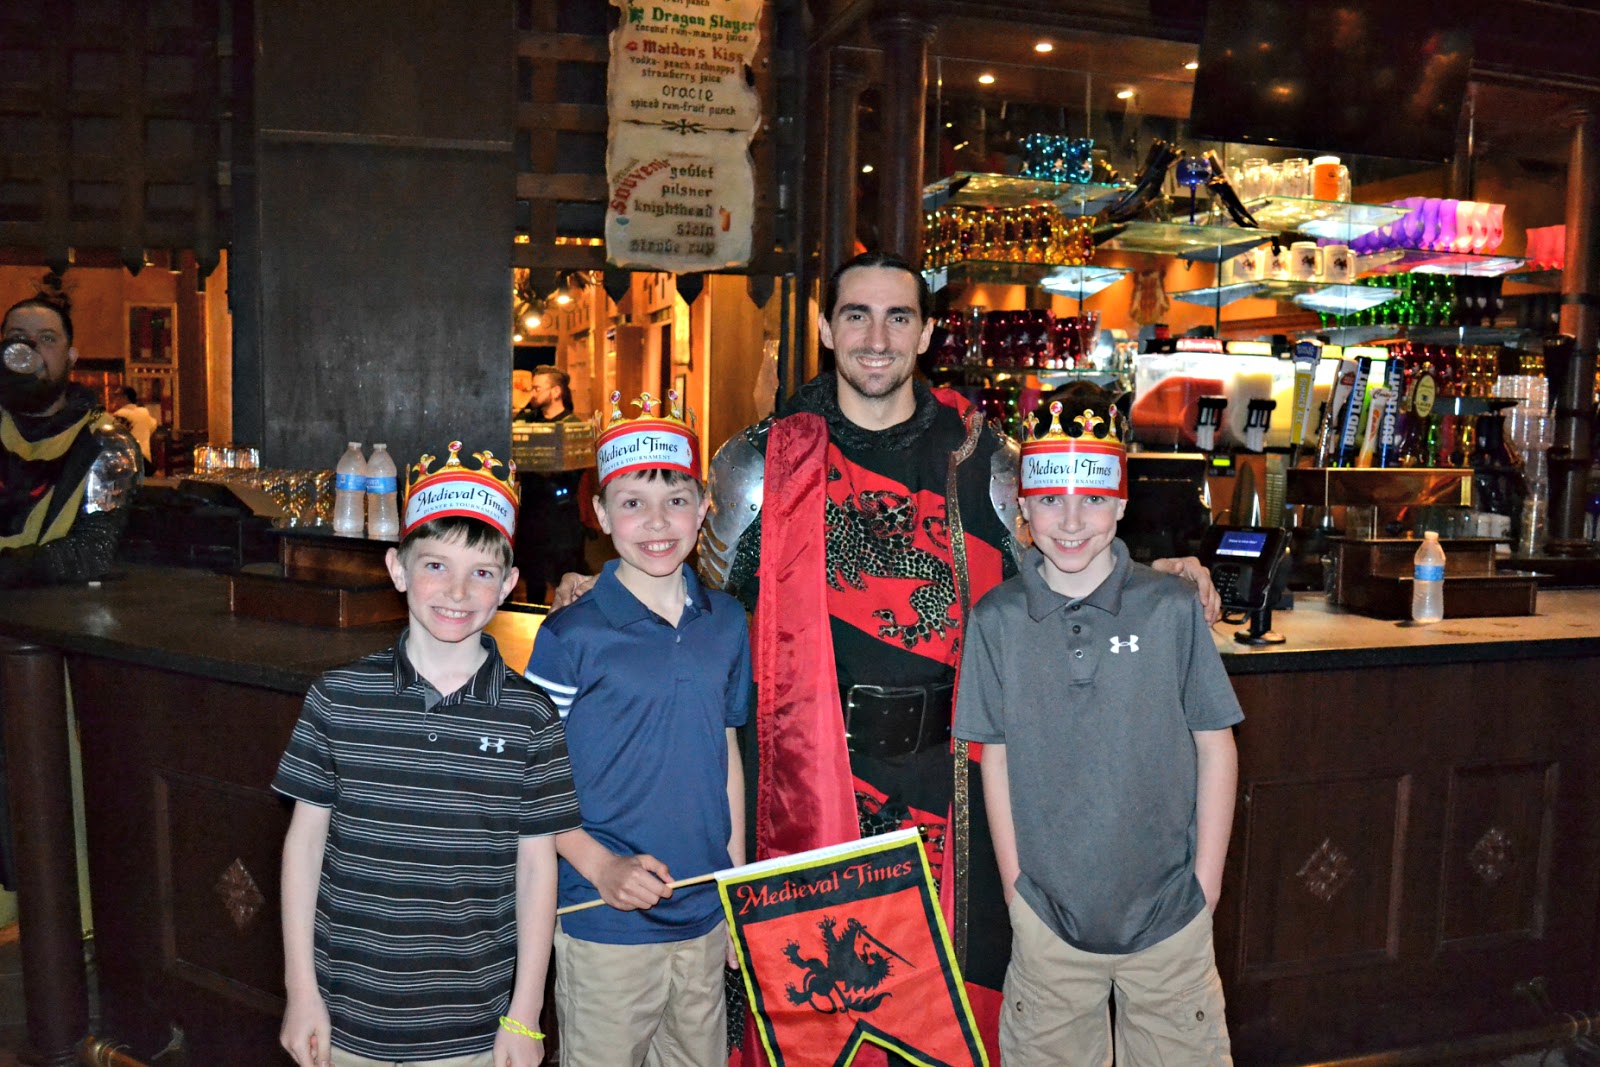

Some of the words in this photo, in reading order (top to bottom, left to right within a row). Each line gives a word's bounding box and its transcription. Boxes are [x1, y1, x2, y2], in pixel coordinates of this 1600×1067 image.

[652, 7, 706, 29] Dragon
[709, 14, 755, 33] Slayer
[726, 31, 748, 44] juice
[642, 40, 706, 59] Maiden's
[712, 46, 744, 63] Kiss
[700, 72, 721, 85] juice
[708, 106, 736, 117] punch
[669, 163, 714, 180] goblet
[661, 183, 713, 198] pilsner
[676, 222, 715, 237] stein
[1351, 371, 1368, 414] LIGHT
[1385, 371, 1400, 414] LIGHT
[1344, 414, 1359, 446] BUD
[1382, 415, 1396, 445] BUD
[599, 437, 640, 471] Medieval
[642, 436, 678, 454] Times
[625, 454, 671, 464] TOURNAMENT
[1028, 457, 1078, 479] Medieval
[1080, 458, 1112, 477] Times
[1061, 478, 1106, 486] TORNAMENT
[416, 487, 475, 513] Medieval
[477, 489, 508, 517] Times
[423, 502, 448, 515] DINNER
[455, 502, 501, 520] TOURNAMENT
[736, 870, 840, 916] Medieval
[842, 860, 914, 889] Times
